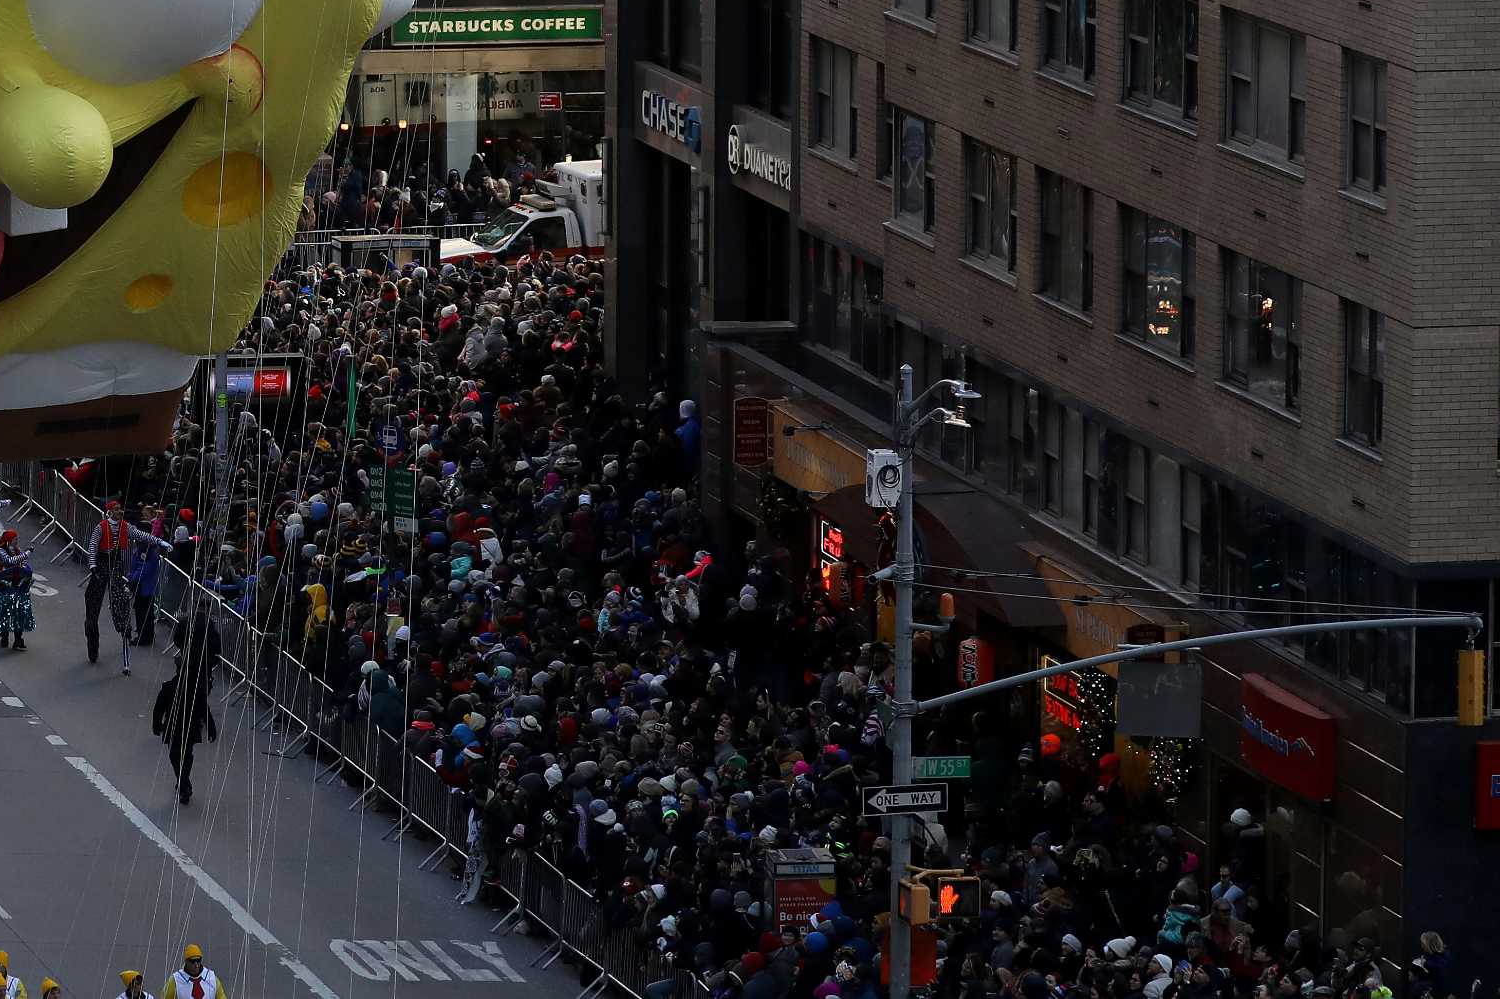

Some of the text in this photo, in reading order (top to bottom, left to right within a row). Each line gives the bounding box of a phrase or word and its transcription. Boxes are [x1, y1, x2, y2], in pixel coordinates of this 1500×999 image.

[408, 17, 586, 34] STARBUCKS COFFEE
[641, 89, 686, 143] CHASE
[743, 143, 792, 192] DUANErea
[929, 759, 967, 776] W 55 ST
[876, 792, 936, 806] ONE WAY
[779, 911, 793, 921] Be
[329, 938, 527, 983] ONLY
